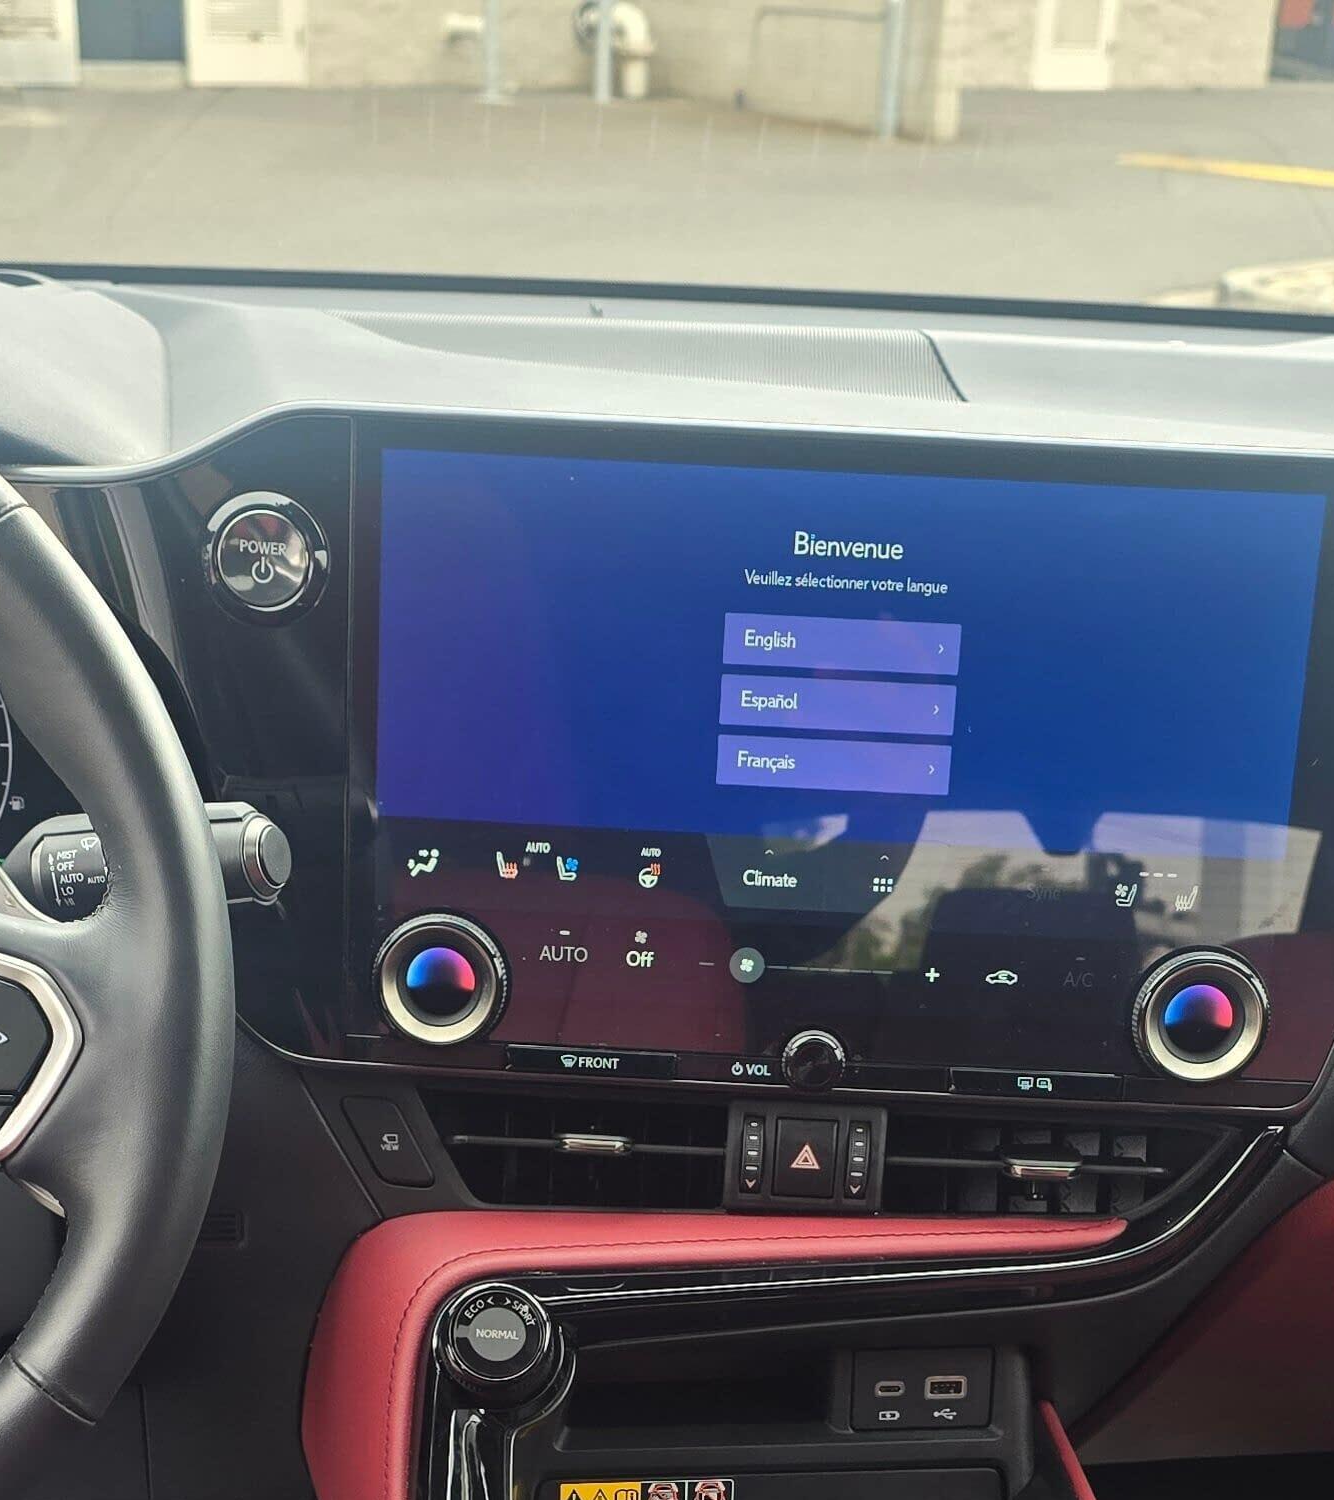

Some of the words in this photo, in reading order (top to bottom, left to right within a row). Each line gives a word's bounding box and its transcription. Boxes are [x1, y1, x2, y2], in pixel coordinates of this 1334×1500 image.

[240, 538, 287, 556] POWER
[793, 530, 904, 560] Bienvenue
[744, 569, 792, 587] Veuillez
[795, 573, 869, 591] sélectionner
[871, 578, 904, 592] votre
[907, 577, 948, 597] langue
[744, 628, 796, 650] English
[740, 690, 798, 711] Español
[737, 750, 796, 773] Français
[525, 842, 551, 854] AUTO
[640, 847, 662, 858] AUTO
[56, 860, 75, 872] OFF
[59, 872, 84, 885] AUTO
[87, 875, 106, 884] AUTO
[742, 869, 798, 889] Climate
[60, 886, 74, 896] LO
[1027, 885, 1061, 901] Sync
[539, 946, 588, 962] AUTO
[625, 950, 655, 968] Off
[1063, 972, 1093, 988] A/C
[578, 1056, 619, 1070] FRONT
[746, 1063, 771, 1077] VOL
[464, 1299, 485, 1320] ECO
[476, 1328, 519, 1340] NORMAL
